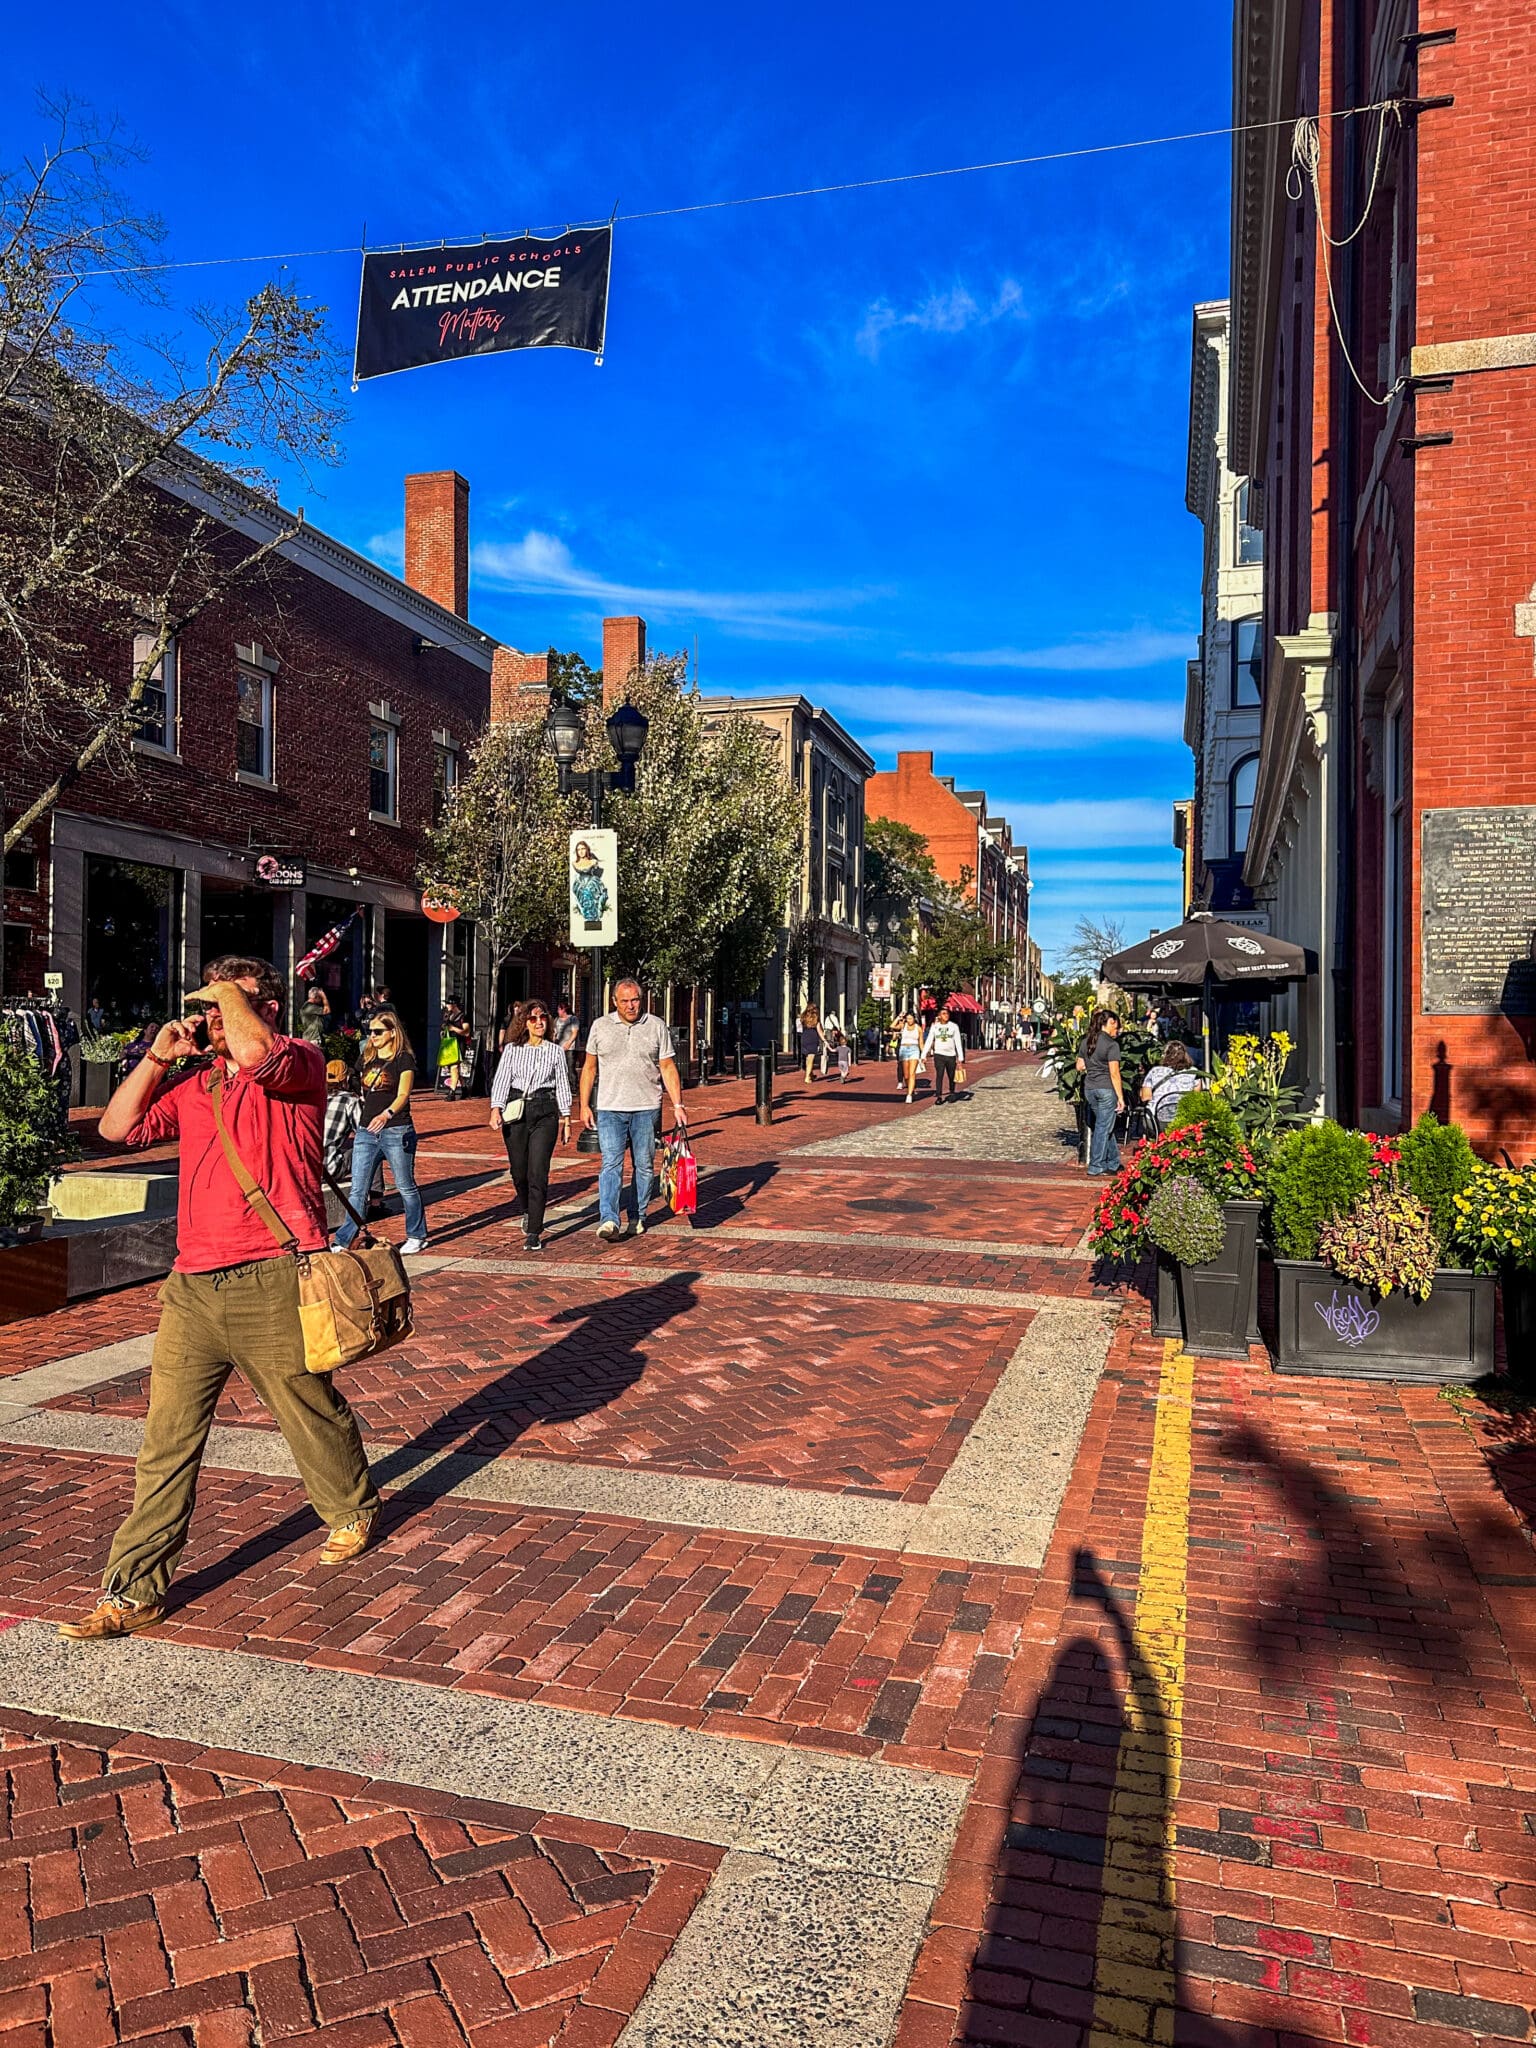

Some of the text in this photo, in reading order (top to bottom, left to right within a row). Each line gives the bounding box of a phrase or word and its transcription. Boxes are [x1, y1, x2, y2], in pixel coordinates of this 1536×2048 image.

[389, 245, 582, 279] SALEM PUBLIC SCHOOLS
[391, 266, 561, 310] ATTENDANCE
[438, 307, 506, 347] Matters
